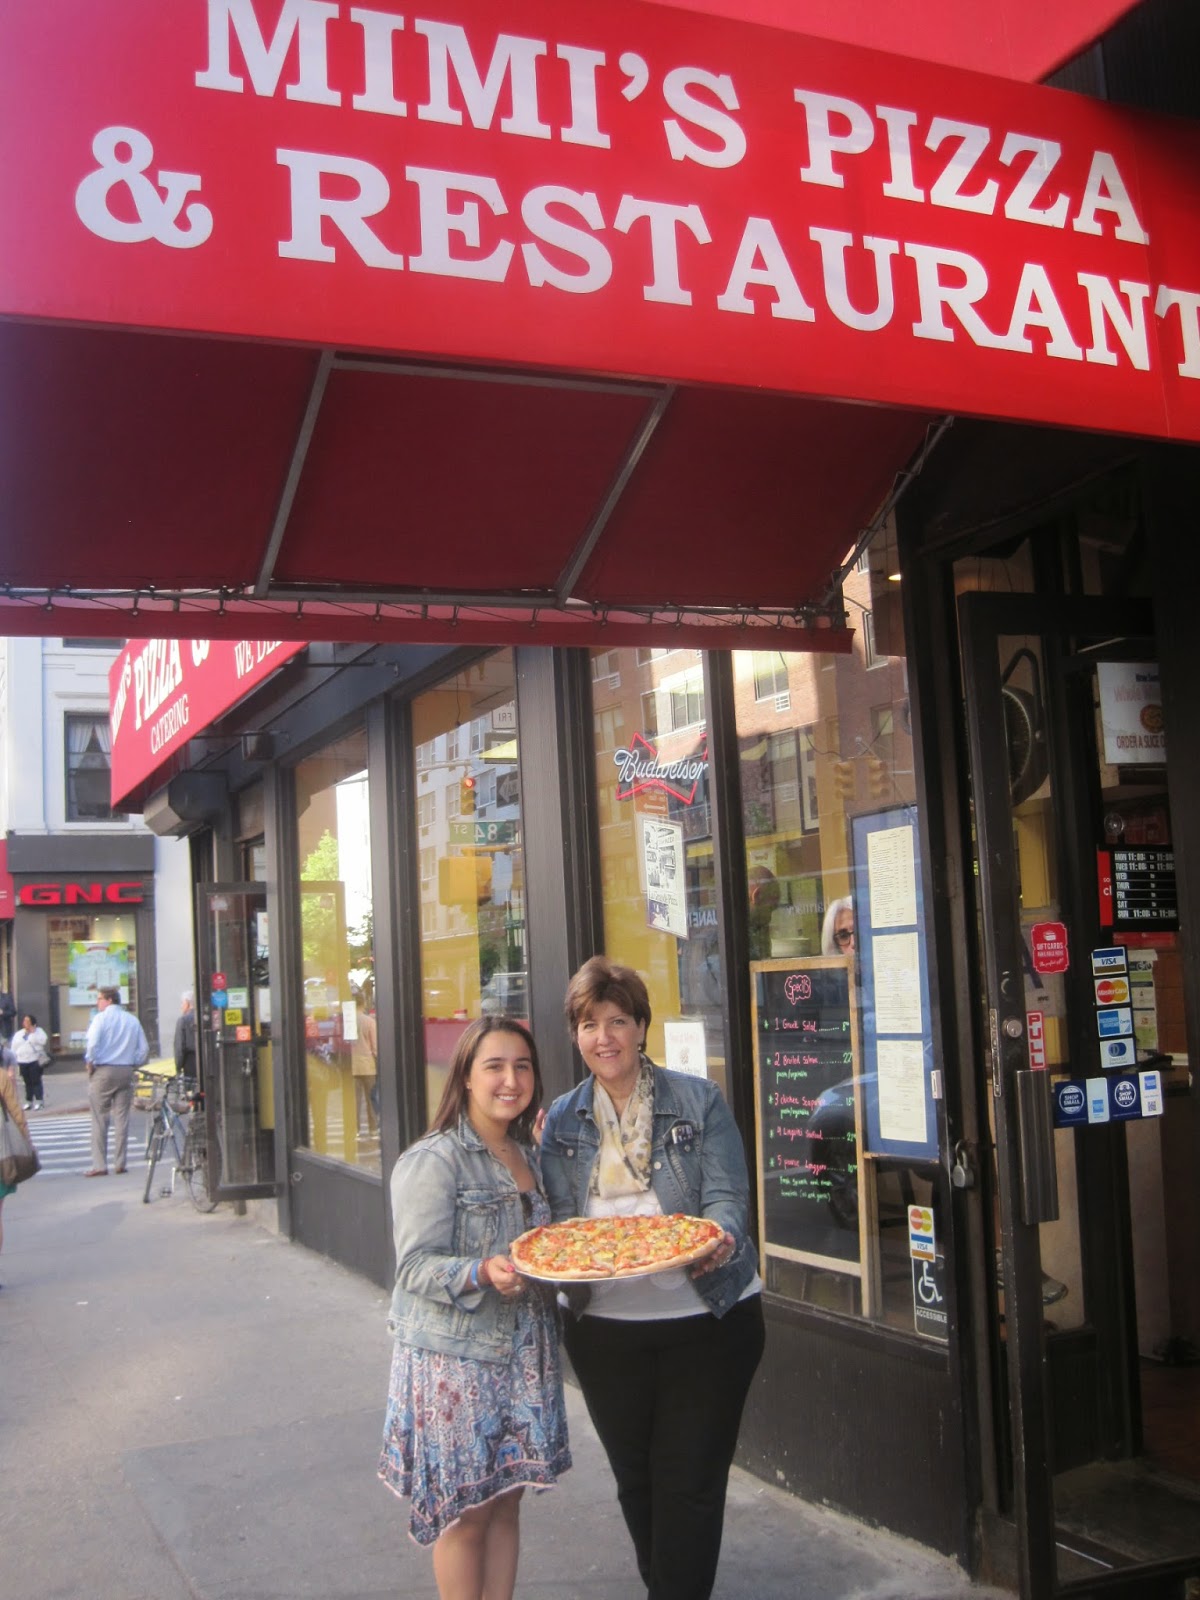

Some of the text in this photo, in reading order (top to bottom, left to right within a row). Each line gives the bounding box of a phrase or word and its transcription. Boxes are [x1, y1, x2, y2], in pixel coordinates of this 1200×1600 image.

[194, 0, 1150, 246] MIMI'S PIZZA
[75, 126, 1200, 380] & RESTAURANT
[133, 639, 183, 731] PIZZA
[151, 693, 189, 755] CATERING
[1117, 735, 1138, 749] ORDER
[614, 749, 708, 782] Budweiser
[20, 882, 143, 905] GNC
[1101, 958, 1117, 966] VISA
[1097, 987, 1127, 996] MasterCard
[1028, 1014, 1044, 1067] PULL
[917, 1243, 928, 1251] VISA
[916, 1309, 947, 1324] ACCESSIBLE
